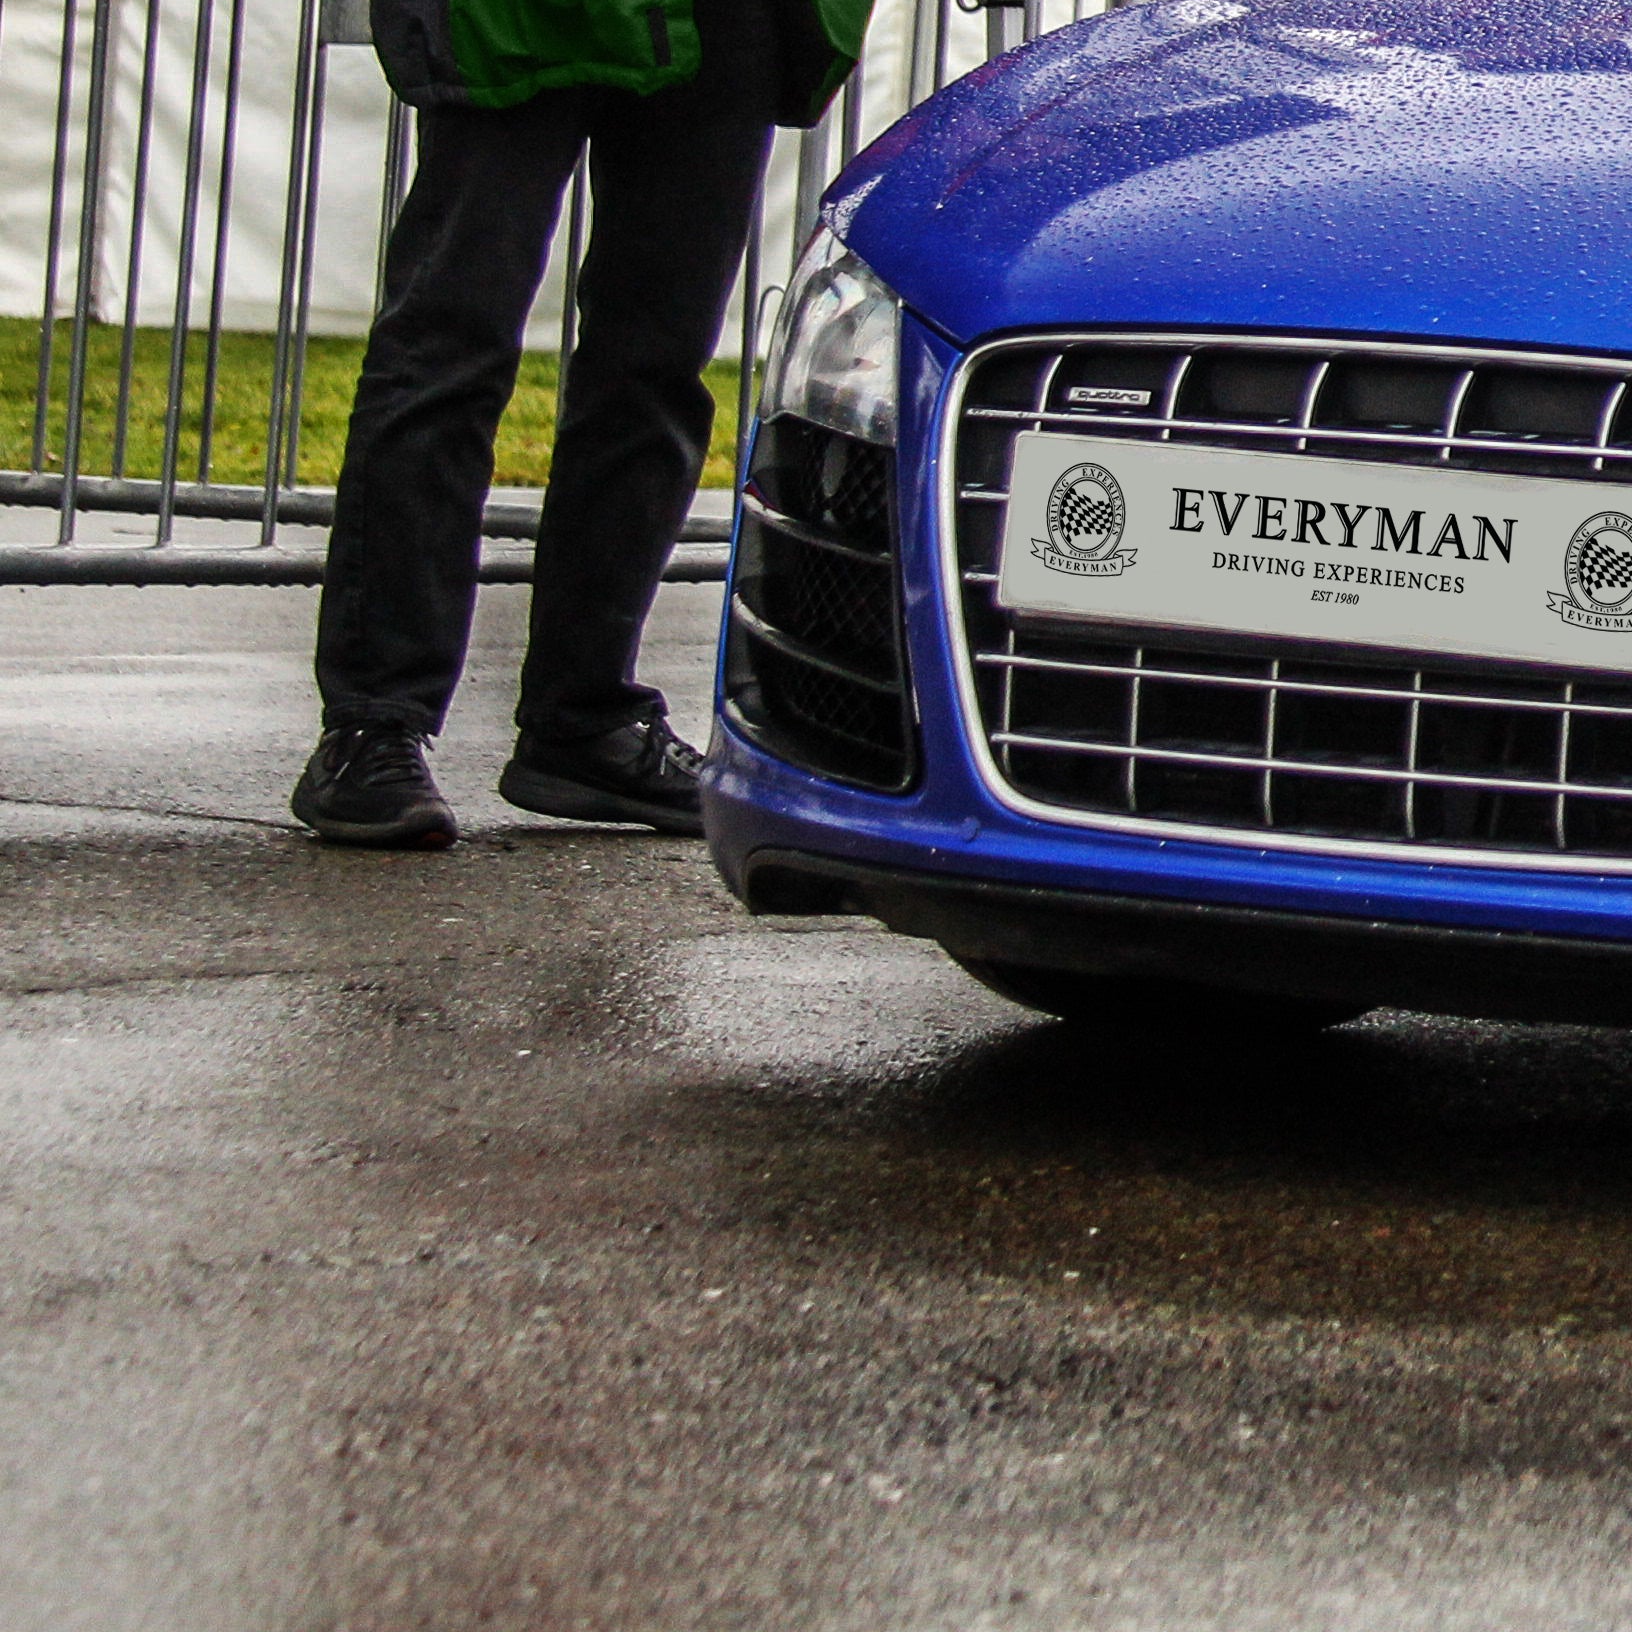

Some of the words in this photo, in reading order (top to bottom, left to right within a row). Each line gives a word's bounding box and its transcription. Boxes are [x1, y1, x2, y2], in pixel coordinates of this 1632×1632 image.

[1077, 390, 1140, 401] quattro
[1050, 478, 1069, 532] DRIVING
[1082, 467, 1122, 536] EXPERIENCES
[1169, 487, 1519, 564] EVERYMAN
[1049, 555, 1118, 572] EVERYMAN
[1212, 551, 1305, 578] DRIVING
[1313, 562, 1465, 594] EXPERIENCES
[1568, 528, 1590, 585] DRIVING
[1310, 589, 1334, 603] EST
[1334, 591, 1360, 606] 1980
